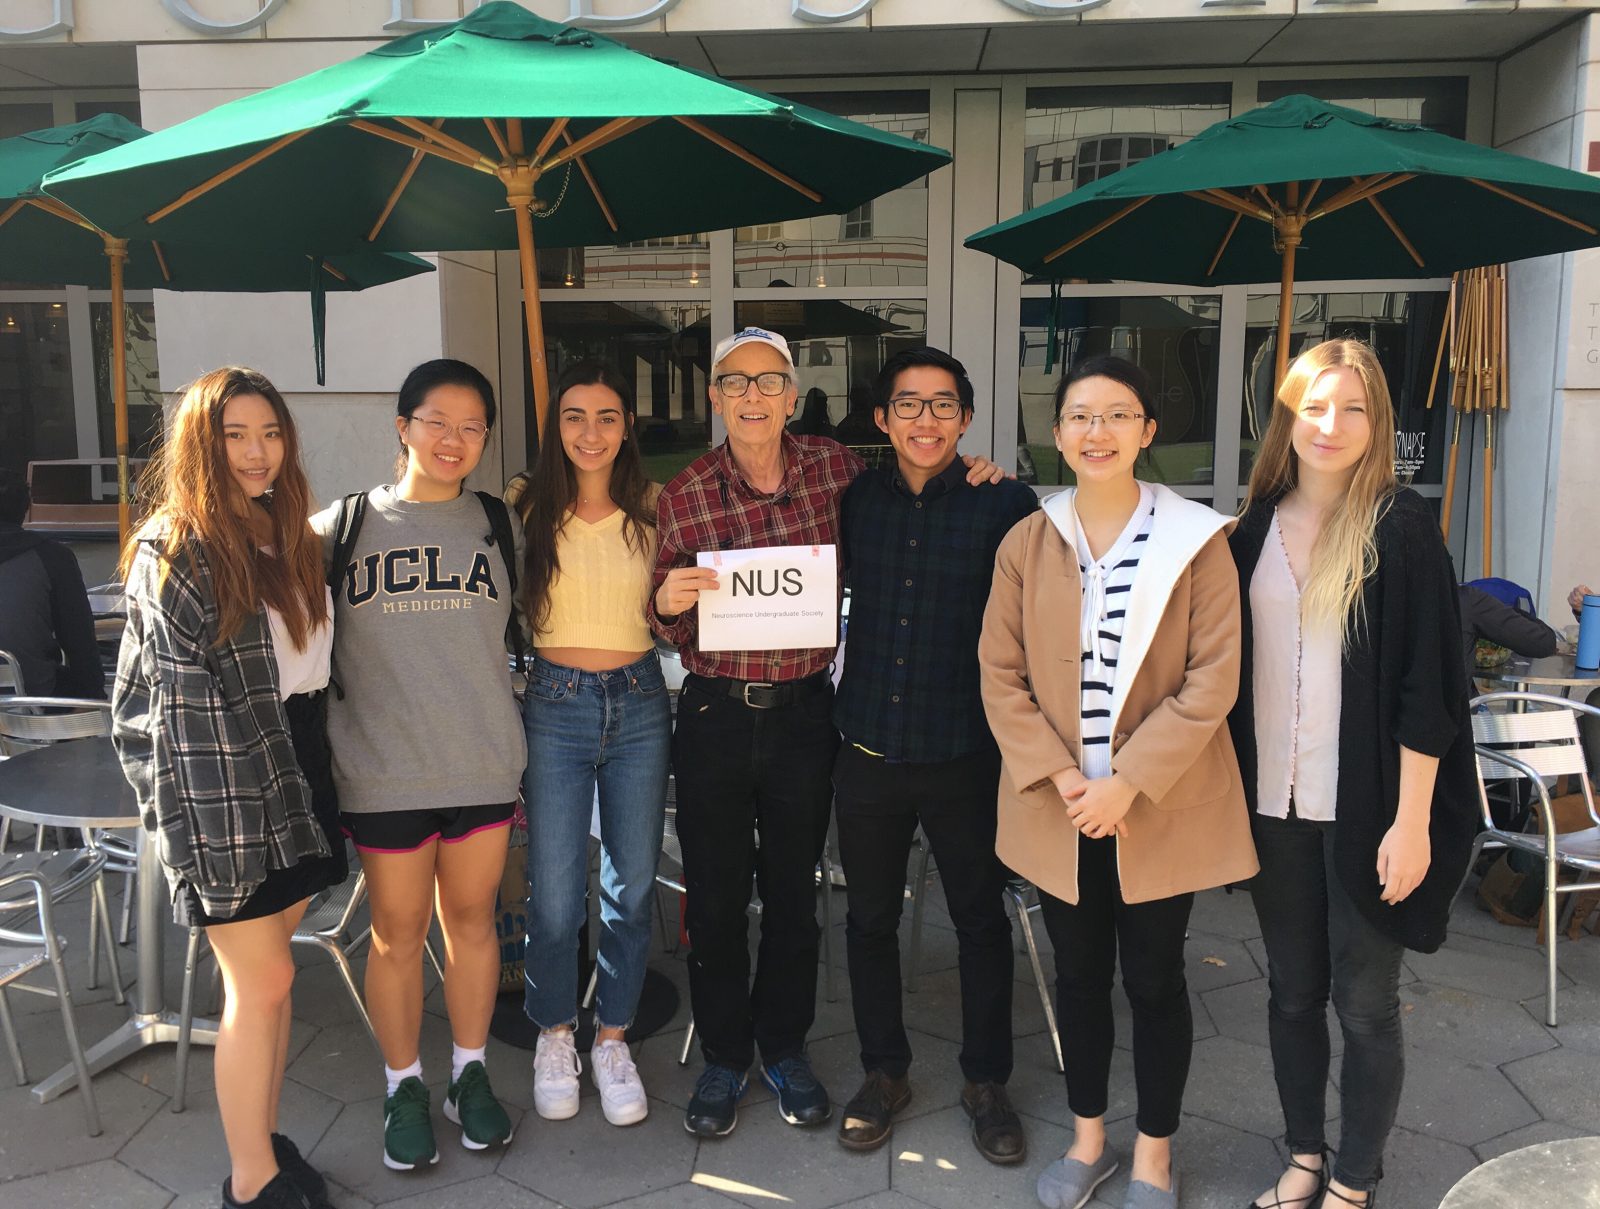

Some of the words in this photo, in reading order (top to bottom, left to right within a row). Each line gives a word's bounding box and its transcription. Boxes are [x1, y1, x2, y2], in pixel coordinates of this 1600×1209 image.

[1394, 430, 1426, 458] YNAPSE
[346, 545, 499, 608] UCLA
[732, 568, 803, 597] NUS
[382, 598, 472, 614] MEDICINE
[711, 611, 754, 619] Neuroscience
[754, 610, 800, 619] Undergraduate
[800, 609, 824, 617] Society
